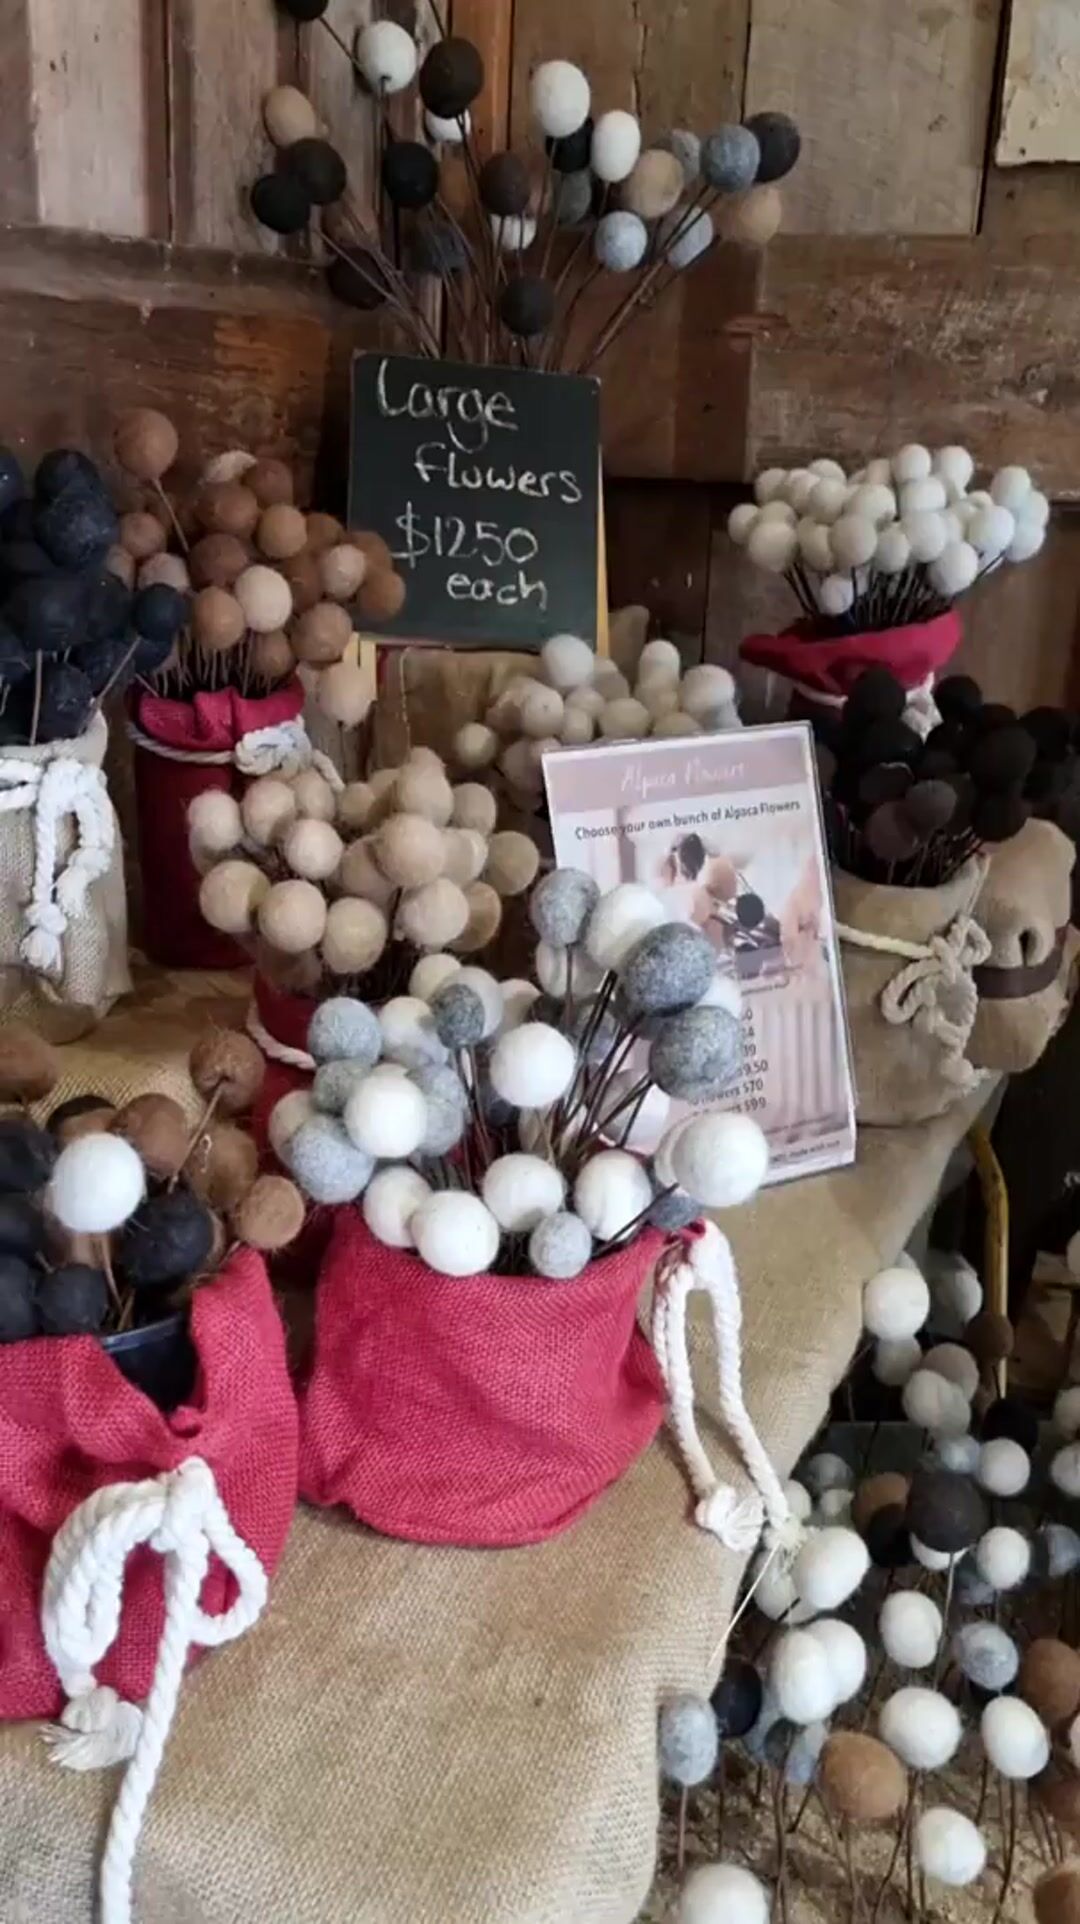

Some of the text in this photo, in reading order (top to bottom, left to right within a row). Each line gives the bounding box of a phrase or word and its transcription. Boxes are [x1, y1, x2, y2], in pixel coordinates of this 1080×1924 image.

[377, 358, 519, 454] Large
[446, 569, 548, 612] each
[620, 763, 676, 799] Alpaca
[574, 800, 800, 840] Choose your own bunch of Alpaca Flowers
[743, 1078, 764, 1094] $70
[744, 1096, 767, 1112] $99
